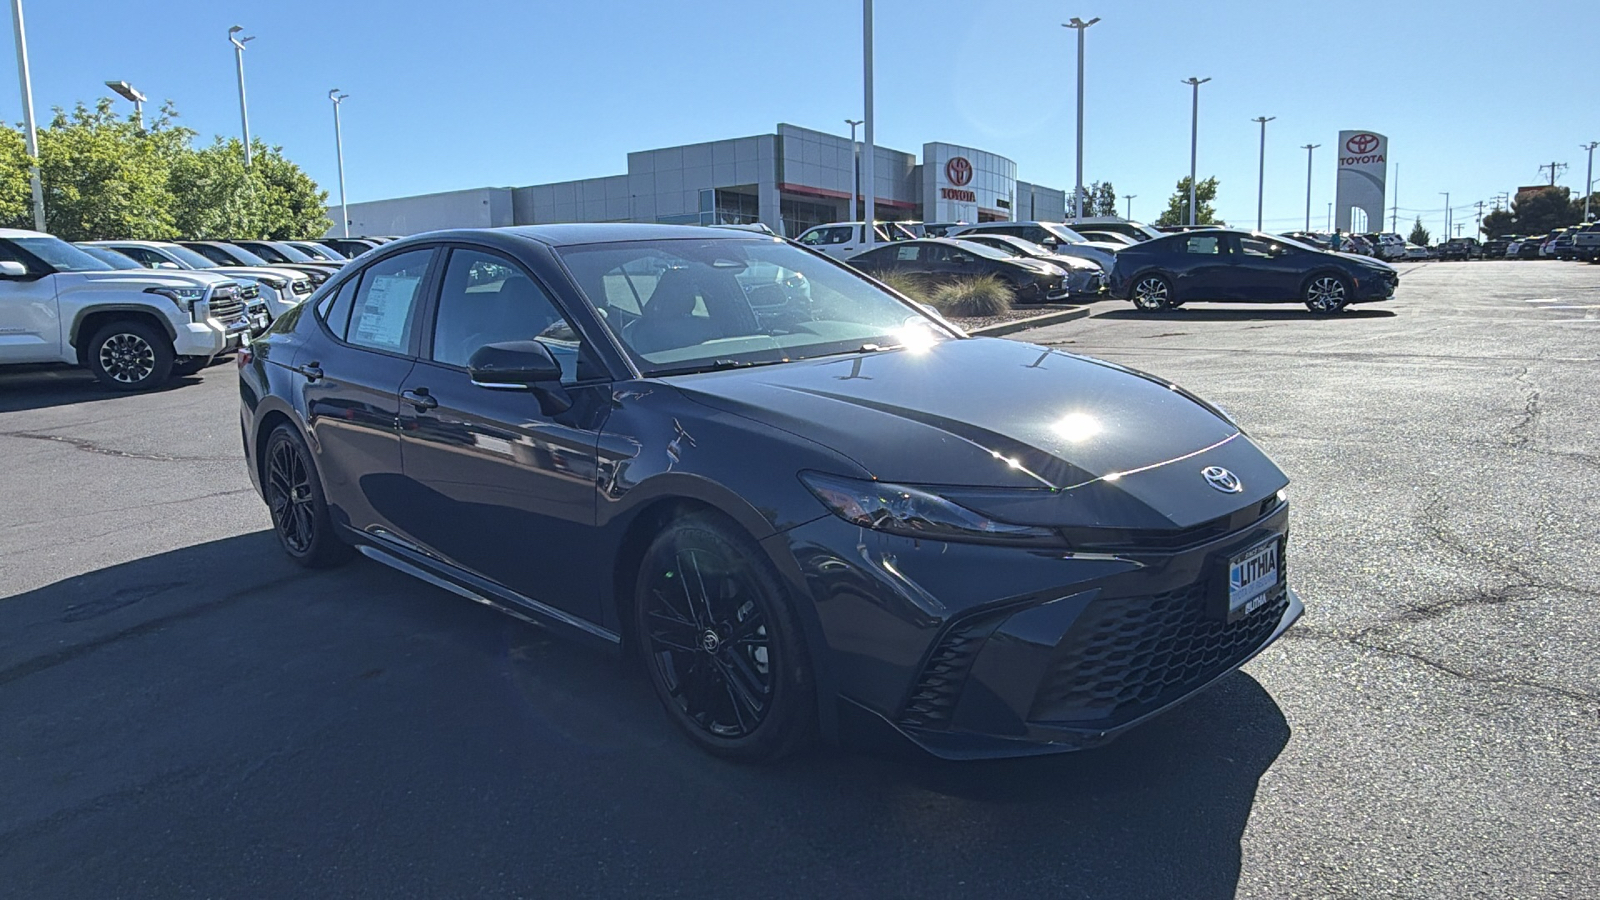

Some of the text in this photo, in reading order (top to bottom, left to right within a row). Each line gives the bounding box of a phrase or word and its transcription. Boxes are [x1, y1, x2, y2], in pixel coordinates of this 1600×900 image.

[1339, 154, 1385, 166] TOYOTA
[941, 187, 976, 203] TOYOTA
[1240, 548, 1276, 588] LITHIA
